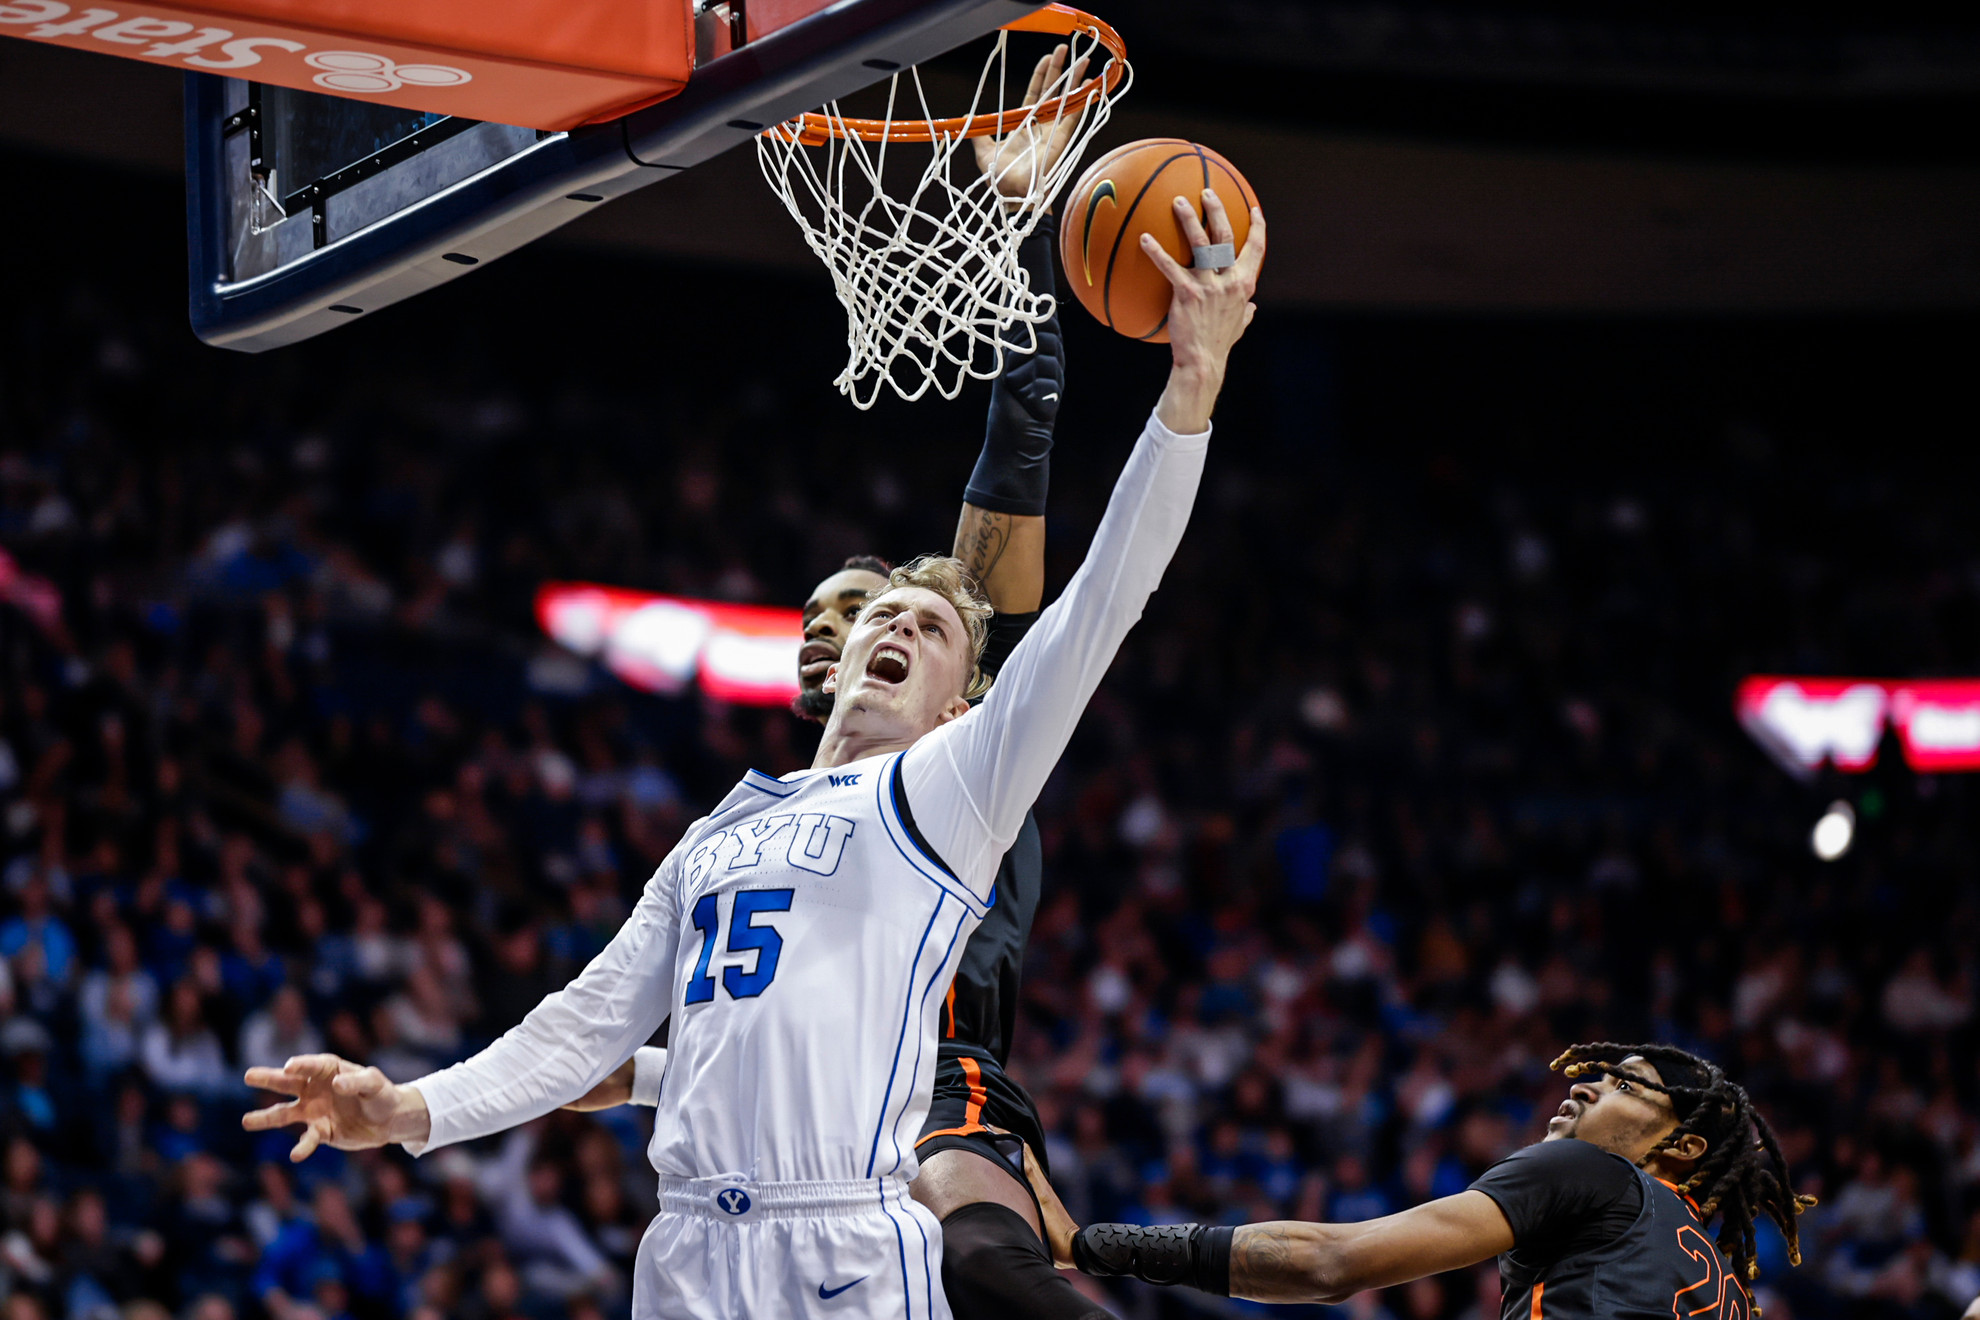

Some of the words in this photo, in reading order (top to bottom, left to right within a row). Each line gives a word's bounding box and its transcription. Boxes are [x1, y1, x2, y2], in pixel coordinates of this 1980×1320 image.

[0, 0, 307, 69] State
[828, 773, 863, 788] WCC
[682, 812, 857, 897] BYU
[684, 887, 796, 1007] 15
[721, 1191, 744, 1213] Y
